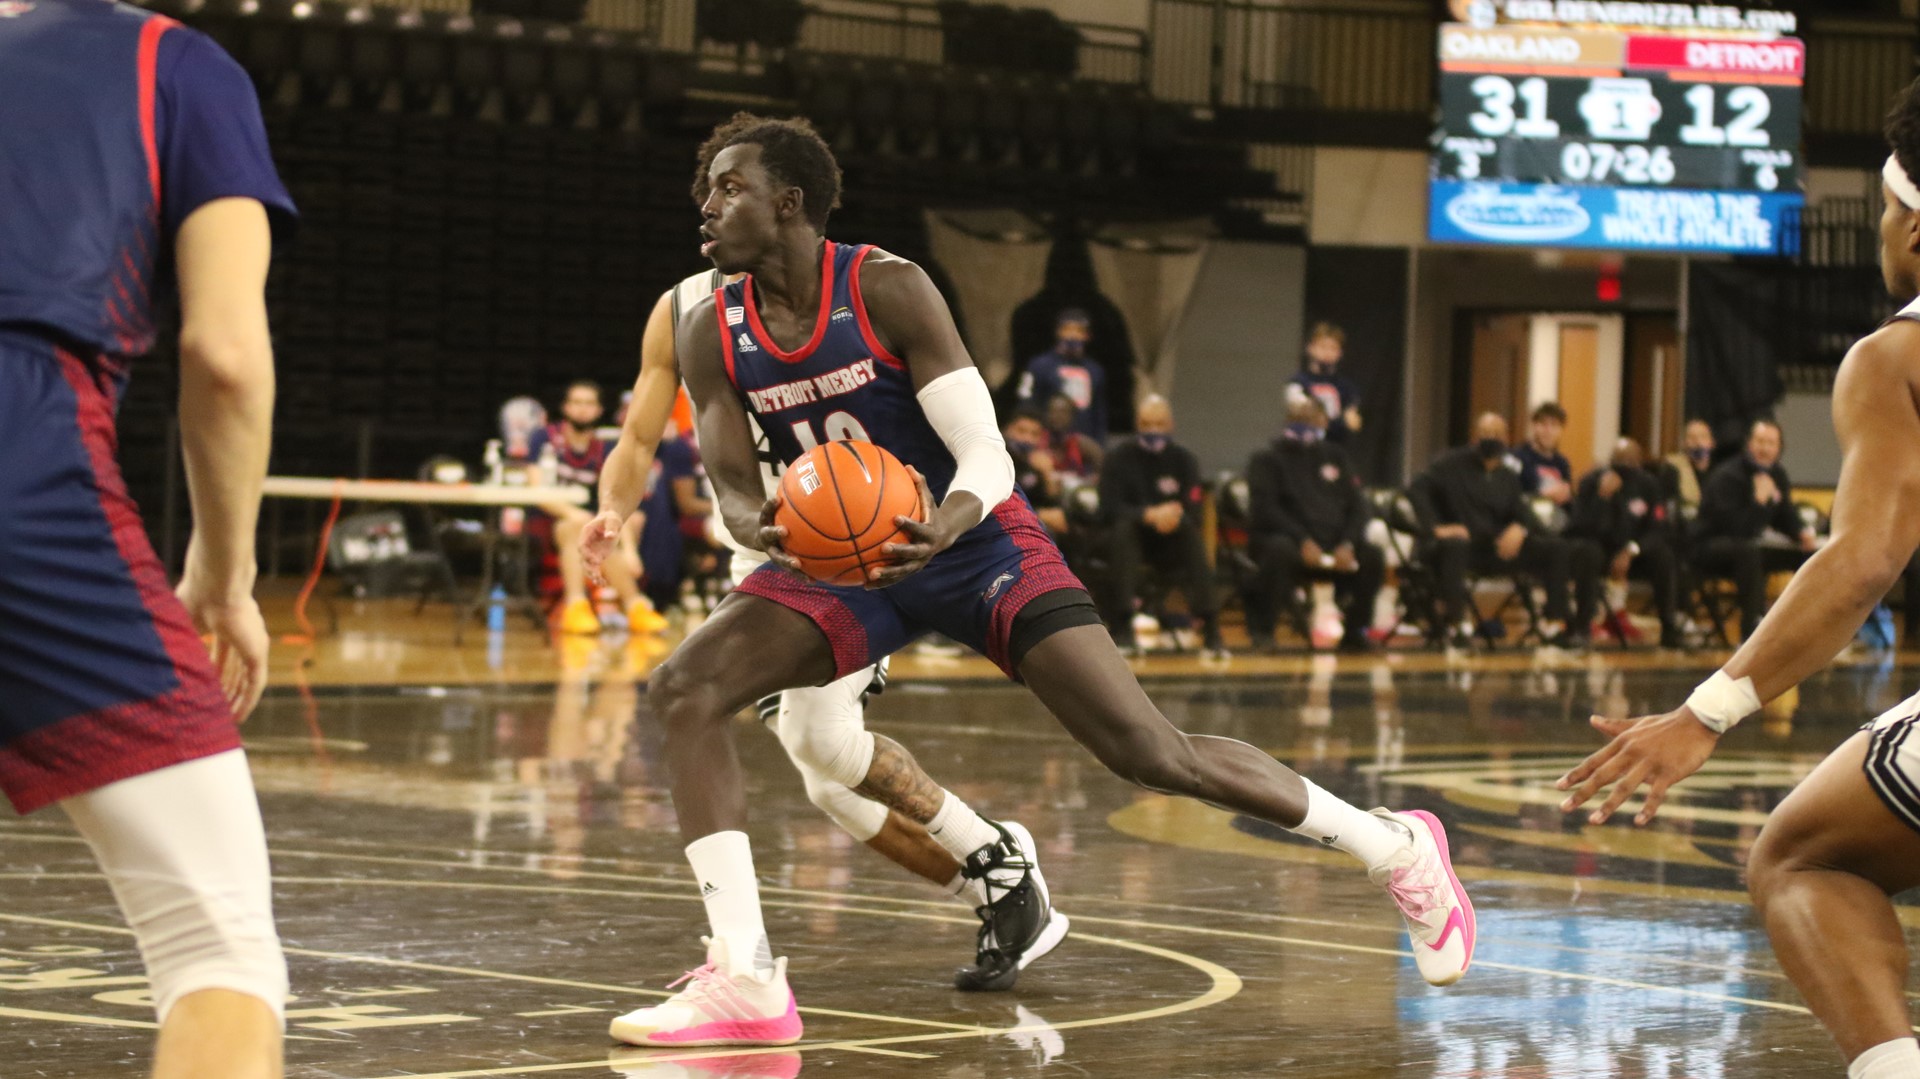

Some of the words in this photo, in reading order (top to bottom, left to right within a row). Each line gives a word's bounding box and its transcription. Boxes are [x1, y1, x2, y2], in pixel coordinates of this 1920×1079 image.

[1443, 32, 1581, 63] OAKLAND
[1686, 41, 1799, 71] DETROIT
[1468, 75, 1560, 138] 31
[1679, 84, 1771, 146] 12
[1457, 153, 1481, 180] 3
[1561, 142, 1676, 183] 07:26
[1755, 165, 1779, 191] 6
[1602, 213, 1678, 244] WHOLE
[1679, 219, 1772, 249] ATHLETE
[746, 379, 818, 415] DETROIT
[813, 358, 877, 398] MERCY
